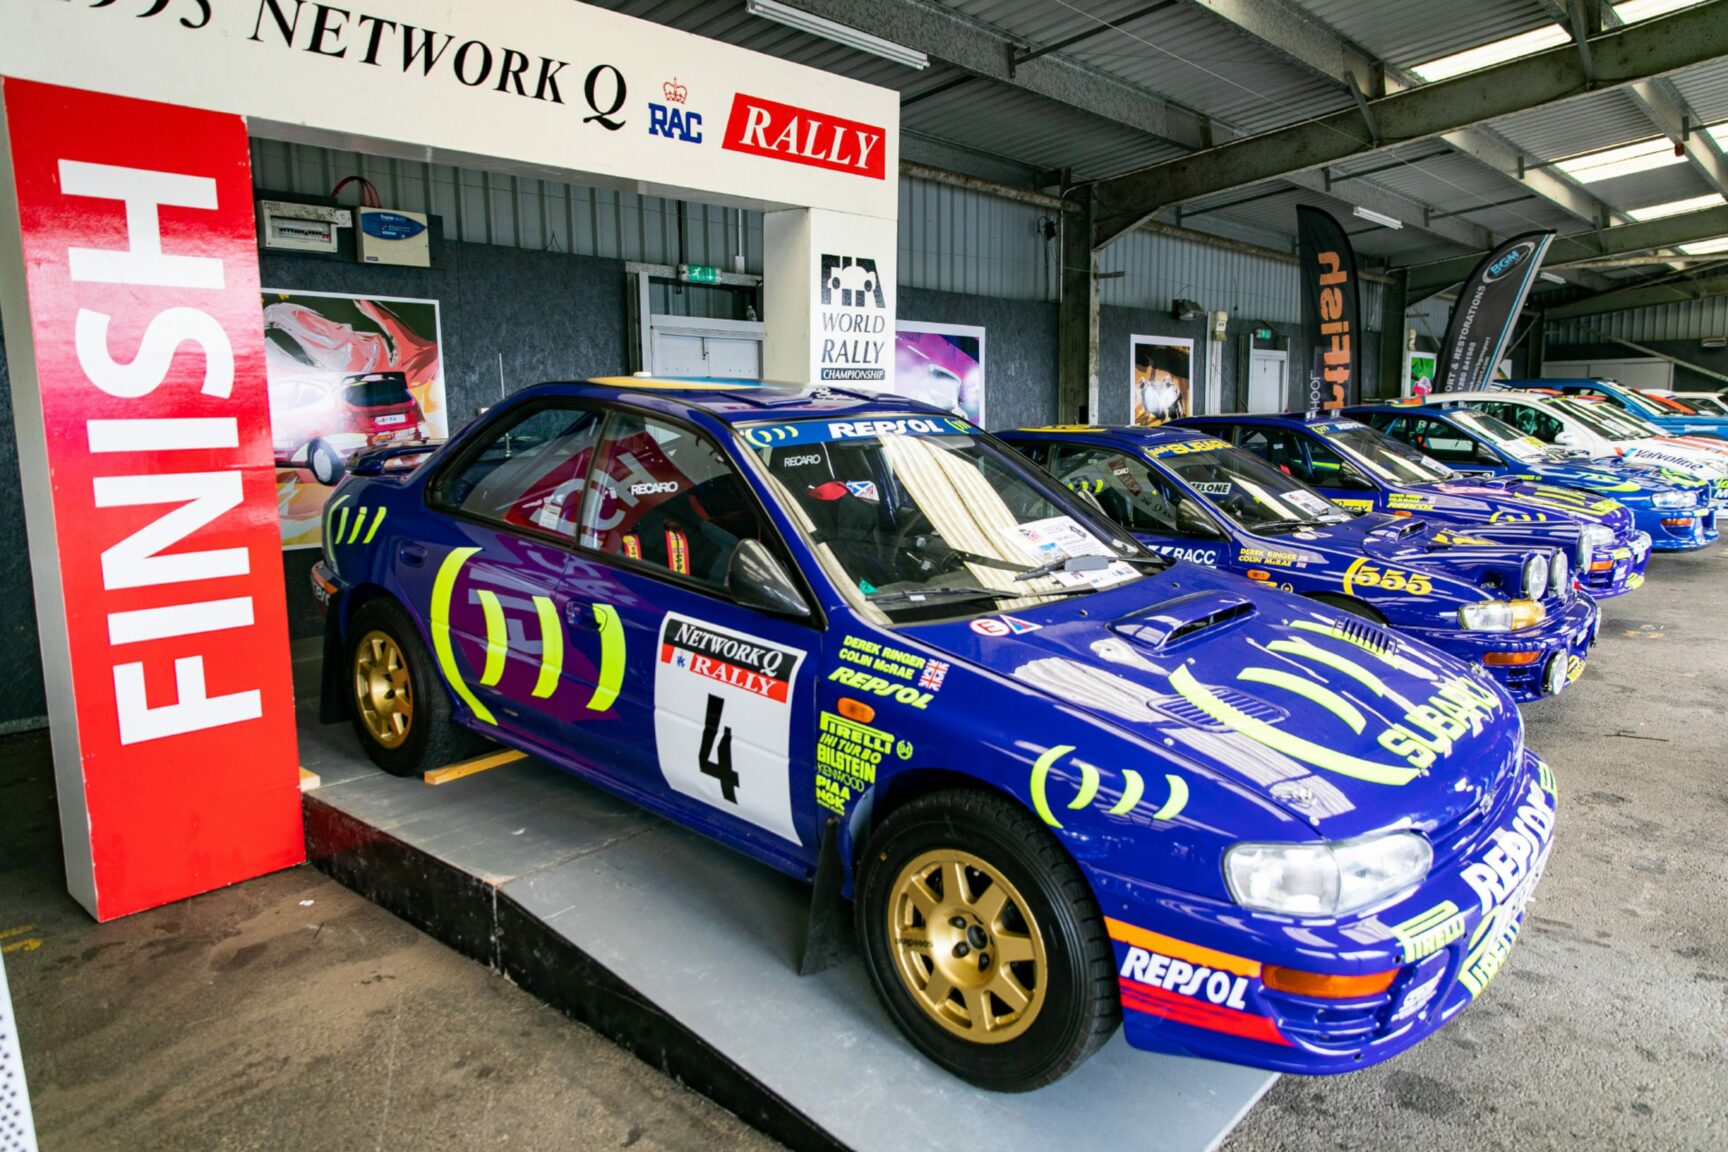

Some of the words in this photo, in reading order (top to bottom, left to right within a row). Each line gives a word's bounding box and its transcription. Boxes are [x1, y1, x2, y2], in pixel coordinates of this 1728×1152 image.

[247, 0, 569, 105] NETWORK
[583, 64, 627, 131] Q
[648, 102, 702, 144] RAC
[739, 105, 879, 169] RALLY
[1490, 250, 1519, 275] BGM
[822, 312, 885, 333] WORLD
[1454, 285, 1486, 360] RESTORATIONS
[821, 338, 885, 364] RALLY
[823, 369, 884, 380] CHAMPIONSHIP
[828, 418, 944, 439] REPSOL
[58, 158, 262, 745] FINISH
[784, 453, 821, 467] RECARO
[1635, 449, 1703, 471] Valvoline
[631, 481, 678, 495] RECARO
[1173, 547, 1216, 564] RACC
[1238, 555, 1262, 564] COLIN
[1240, 548, 1264, 557] DEREK
[1267, 551, 1297, 560] RINGER
[1354, 565, 1433, 596] 555
[838, 648, 873, 668] COLIN
[873, 659, 915, 680] McRAE
[843, 635, 880, 655] DEREK
[882, 647, 926, 669] RINGER
[693, 656, 776, 695] RALLY
[828, 666, 934, 710] REPSOL
[820, 710, 895, 755] PIRELLI
[699, 693, 740, 805] 4
[817, 743, 876, 784] BILSTEIN
[838, 739, 882, 764] TURBO
[816, 774, 850, 801] PIAA
[817, 763, 864, 793] KENWOOD
[816, 787, 845, 810] NGK
[1460, 780, 1555, 917] REPSOL
[1119, 946, 1248, 1010] REPSOL
